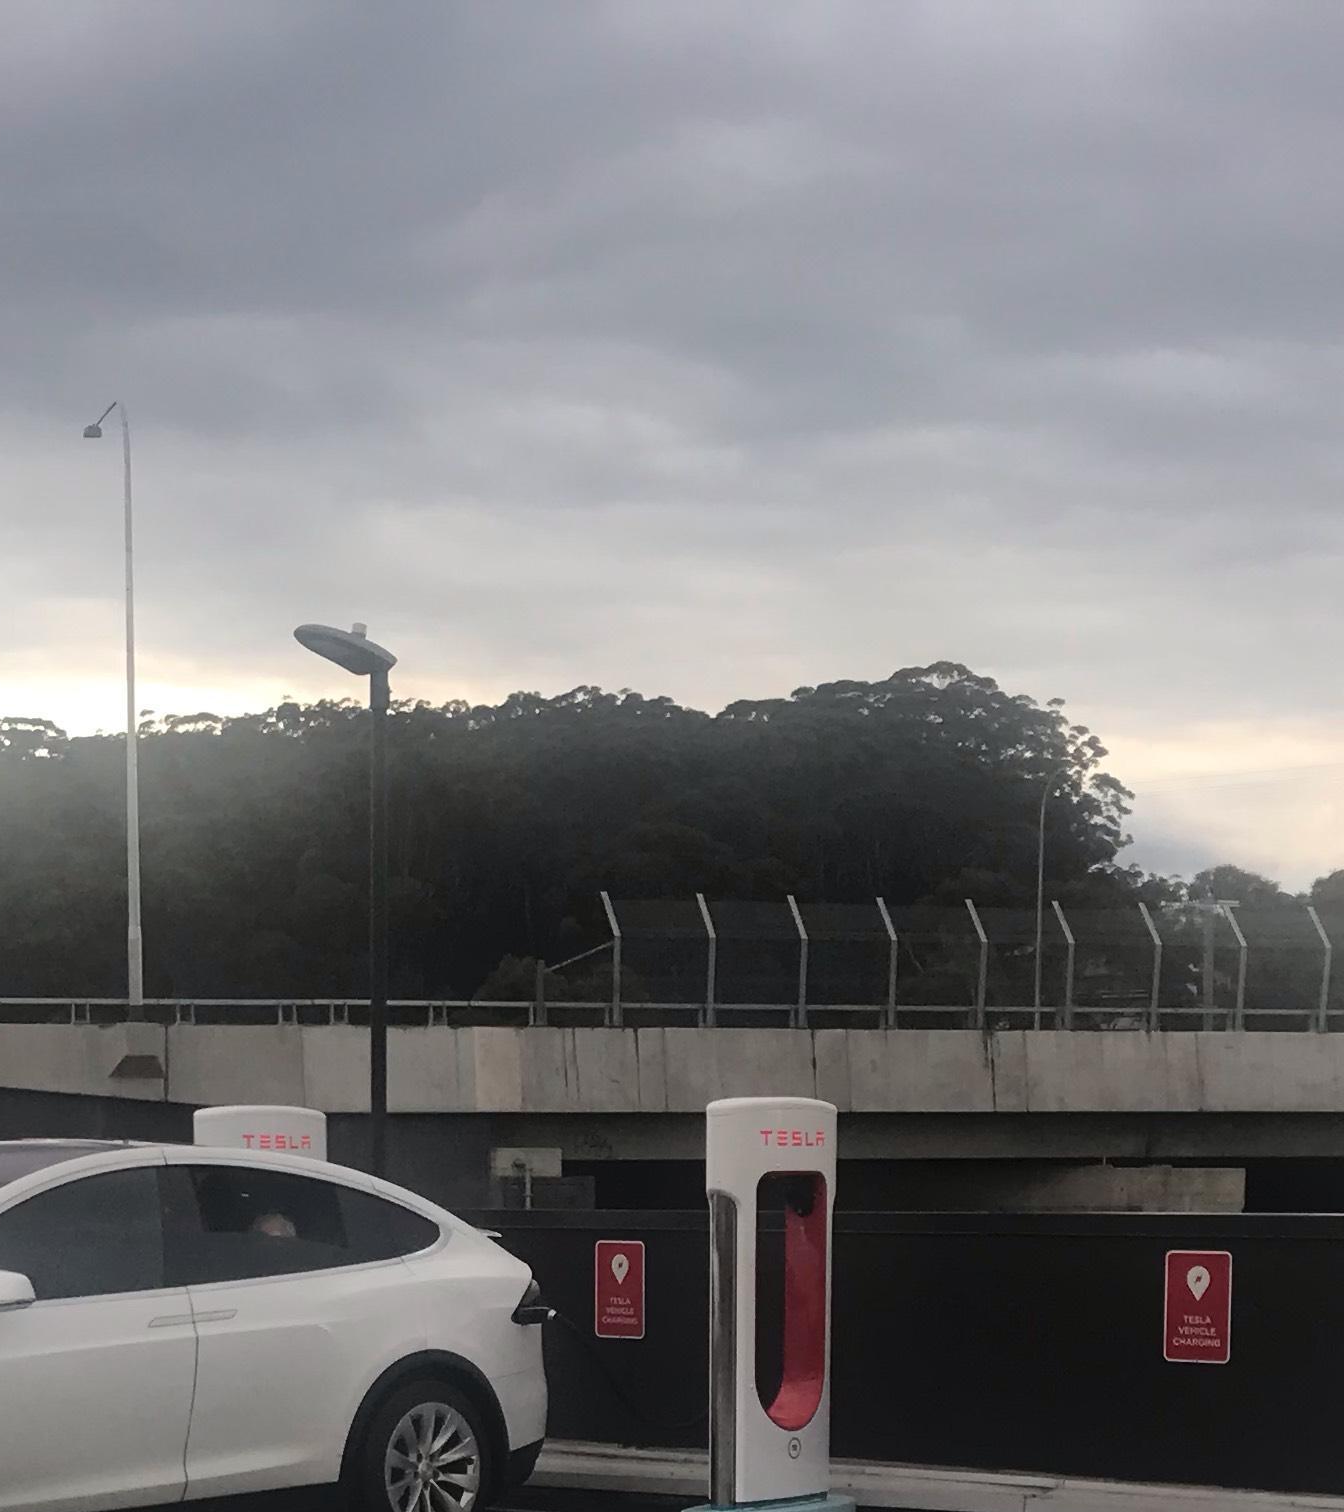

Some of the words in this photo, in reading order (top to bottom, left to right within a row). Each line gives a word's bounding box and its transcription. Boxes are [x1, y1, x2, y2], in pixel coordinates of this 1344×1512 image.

[242, 1134, 312, 1149] TESLA
[760, 1130, 825, 1147] TESLA
[1184, 1315, 1211, 1324] TESLA
[1178, 1326, 1216, 1336] VEHICLE
[1173, 1338, 1220, 1347] CHARGING
